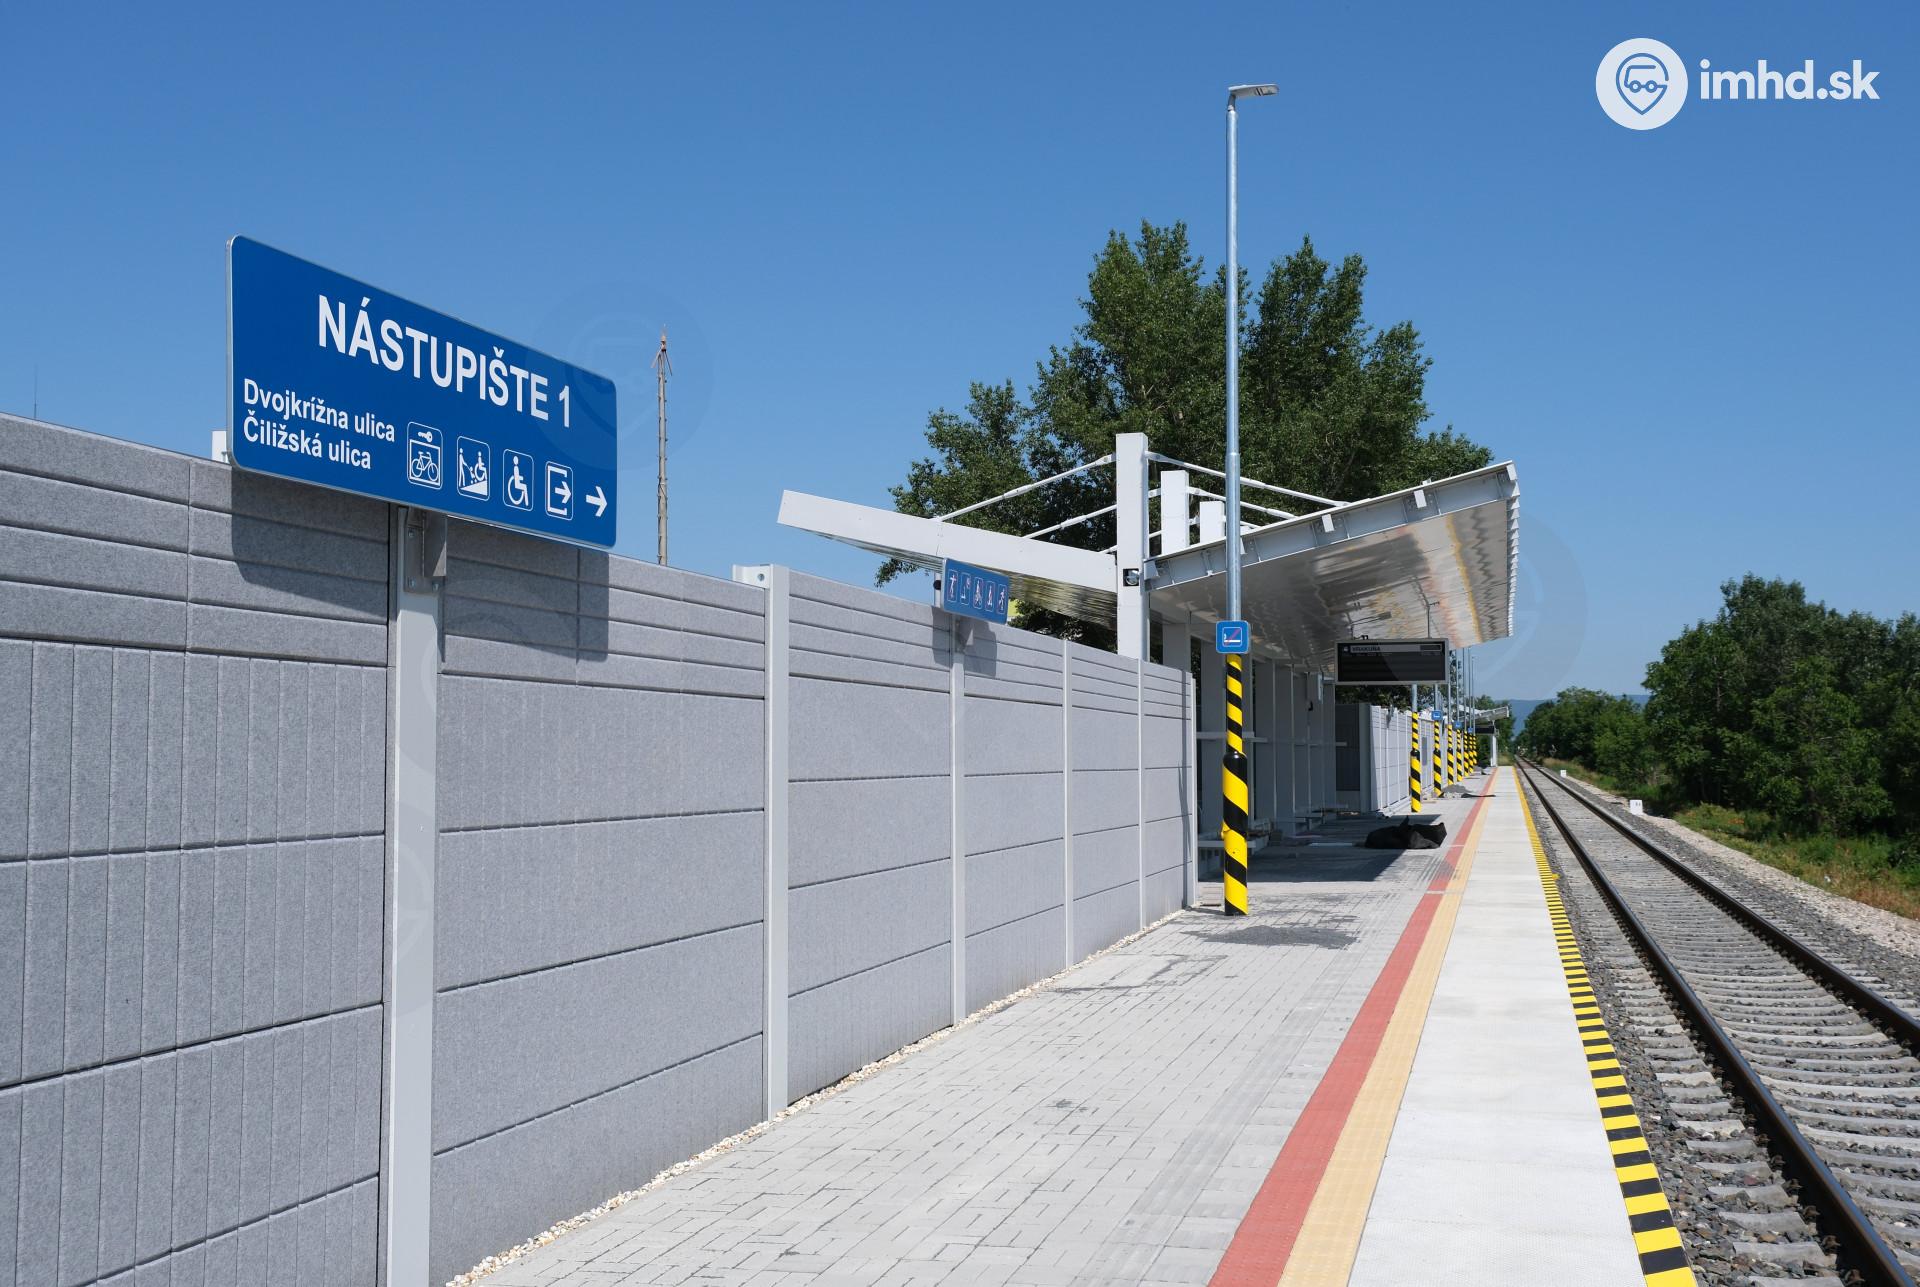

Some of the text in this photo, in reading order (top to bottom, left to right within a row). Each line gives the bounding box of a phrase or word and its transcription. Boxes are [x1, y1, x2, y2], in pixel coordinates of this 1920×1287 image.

[318, 294, 572, 428] NÁSTUPIŠTE 1
[243, 409, 371, 470] Čiližská ulica
[244, 378, 395, 442] Dvojkrížna ulica
